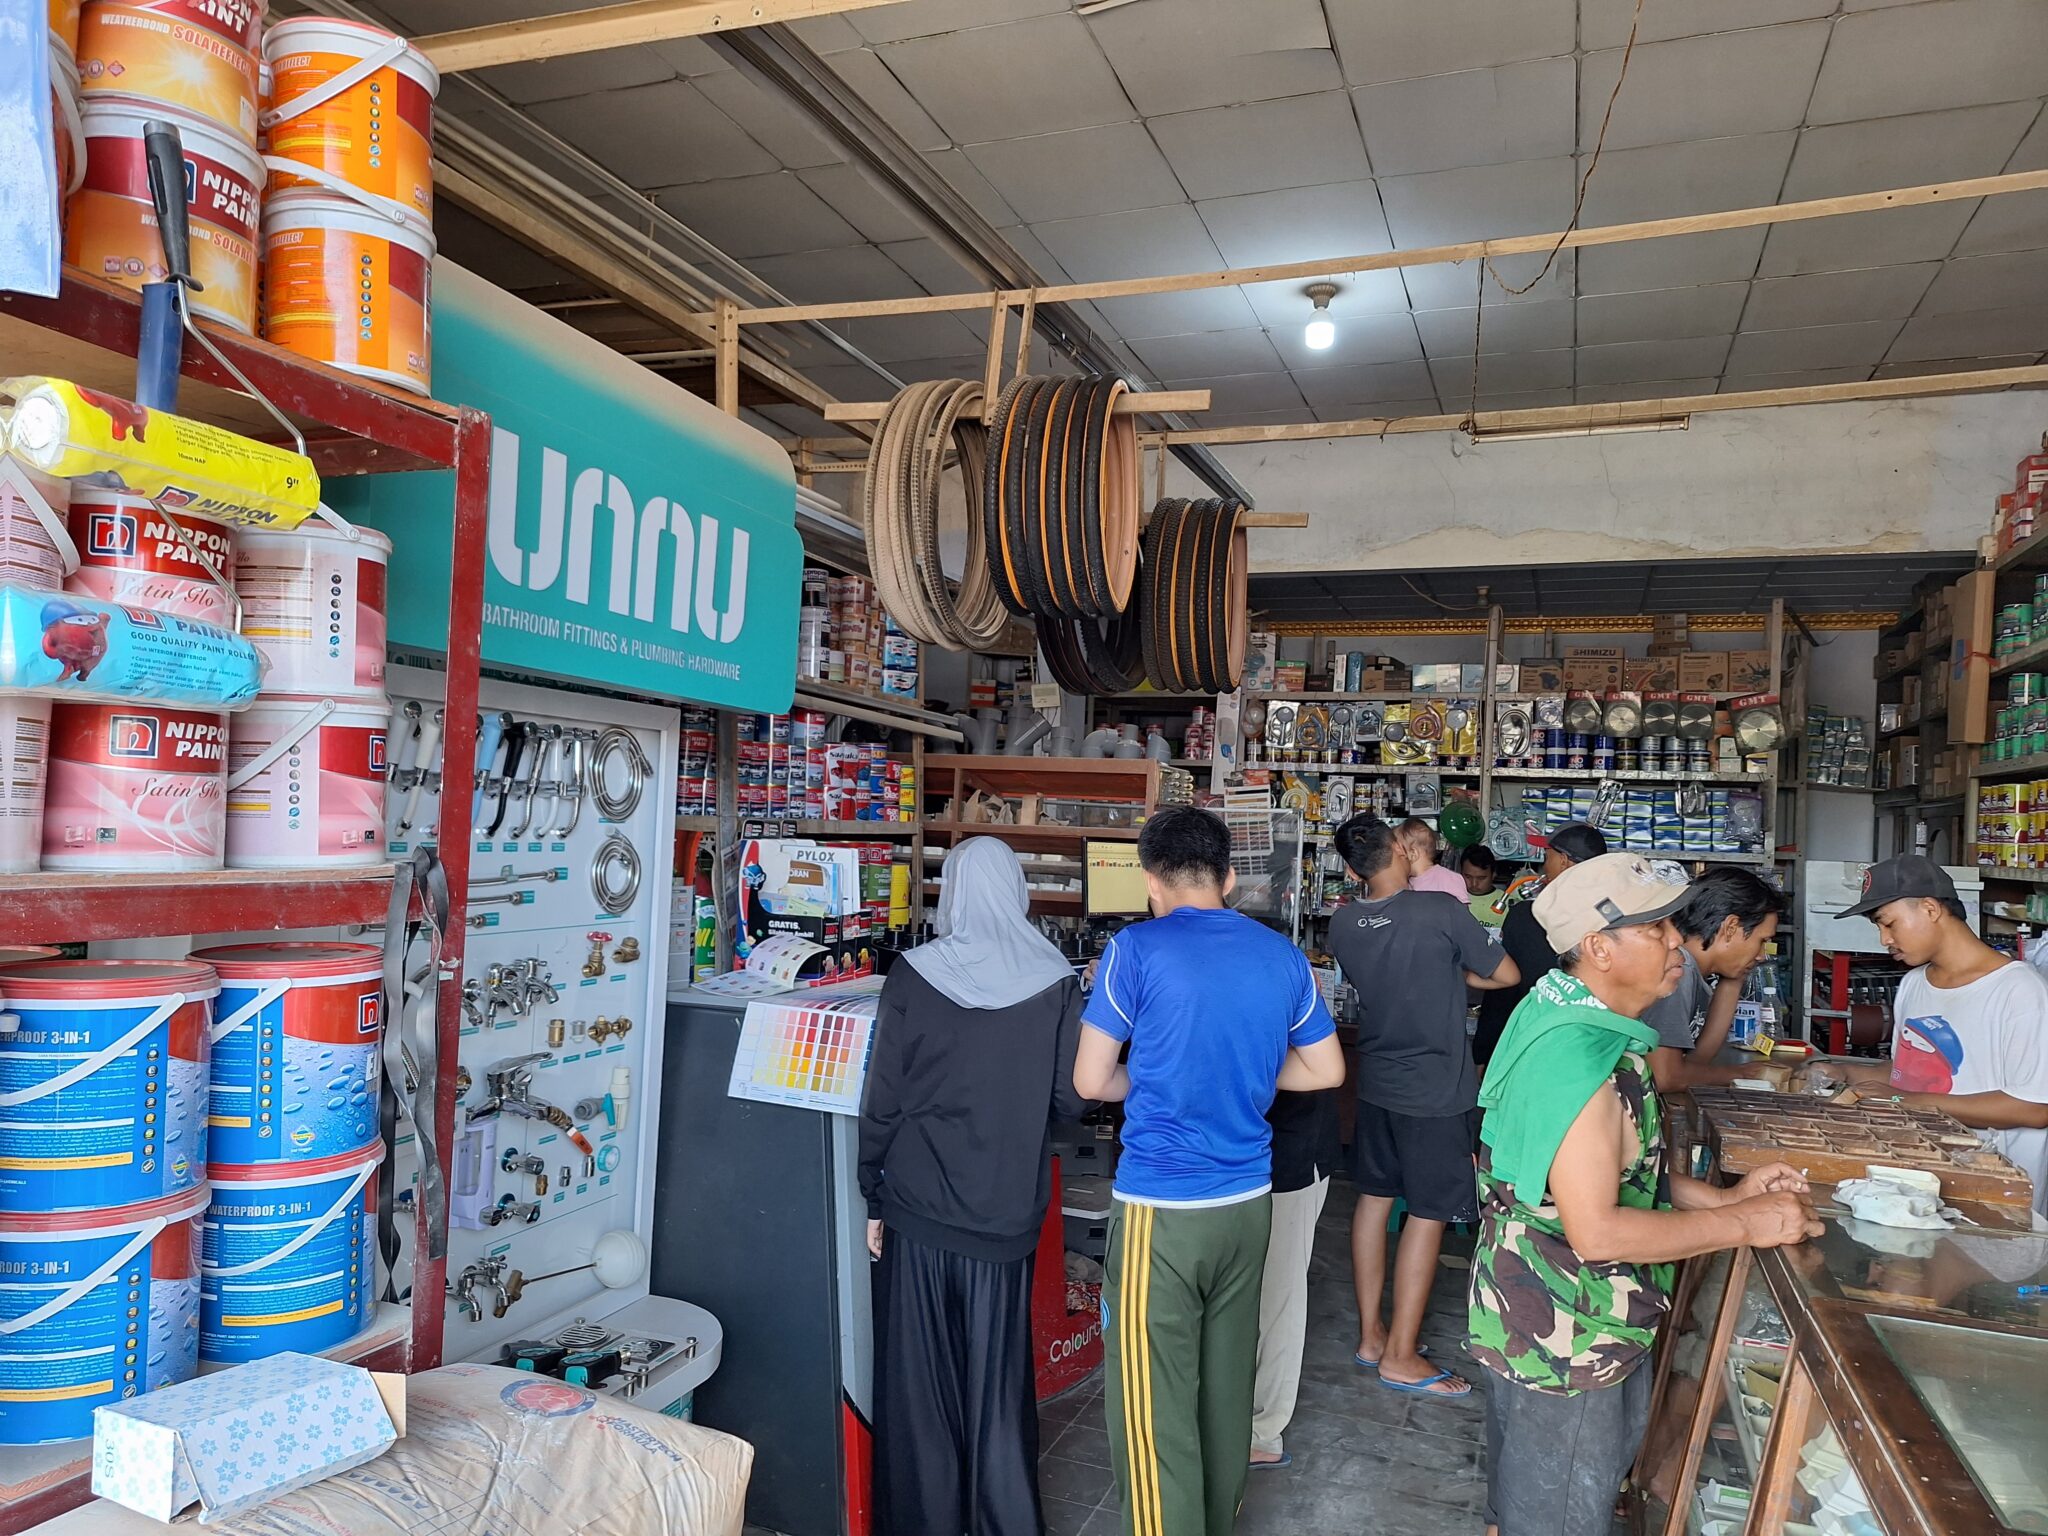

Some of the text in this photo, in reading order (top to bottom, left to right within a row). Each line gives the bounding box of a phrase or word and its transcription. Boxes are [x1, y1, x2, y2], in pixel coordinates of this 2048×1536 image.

[101, 13, 170, 34] WEATHERBOND
[202, 169, 260, 214] NIPPO
[198, 498, 279, 525] NIPPON
[144, 521, 231, 556] NIPPON
[155, 541, 226, 570] PAINT
[184, 586, 214, 607] Glo
[175, 620, 234, 642] PAINT
[131, 631, 256, 662] GOOD QUALITY PAINT ROLLER
[482, 602, 741, 681] BATHROOM FITTINGS & PLUMBING HARDWARE
[148, 647, 173, 657] INTERIOR
[1572, 648, 1616, 657] SHIMIZU
[1686, 694, 1709, 702] GMT
[1739, 695, 1768, 707] GMT
[175, 740, 227, 760] PAINT
[1569, 756, 1584, 764] NO
[796, 850, 836, 862] PYLOX
[1734, 1006, 1755, 1016] vian
[50, 1030, 91, 1045] 3-IN-1
[209, 1201, 312, 1217] WATERPROOF 3-IN-1
[31, 1260, 70, 1275] 3-IN-1
[606, 1421, 658, 1455] FORMULA
